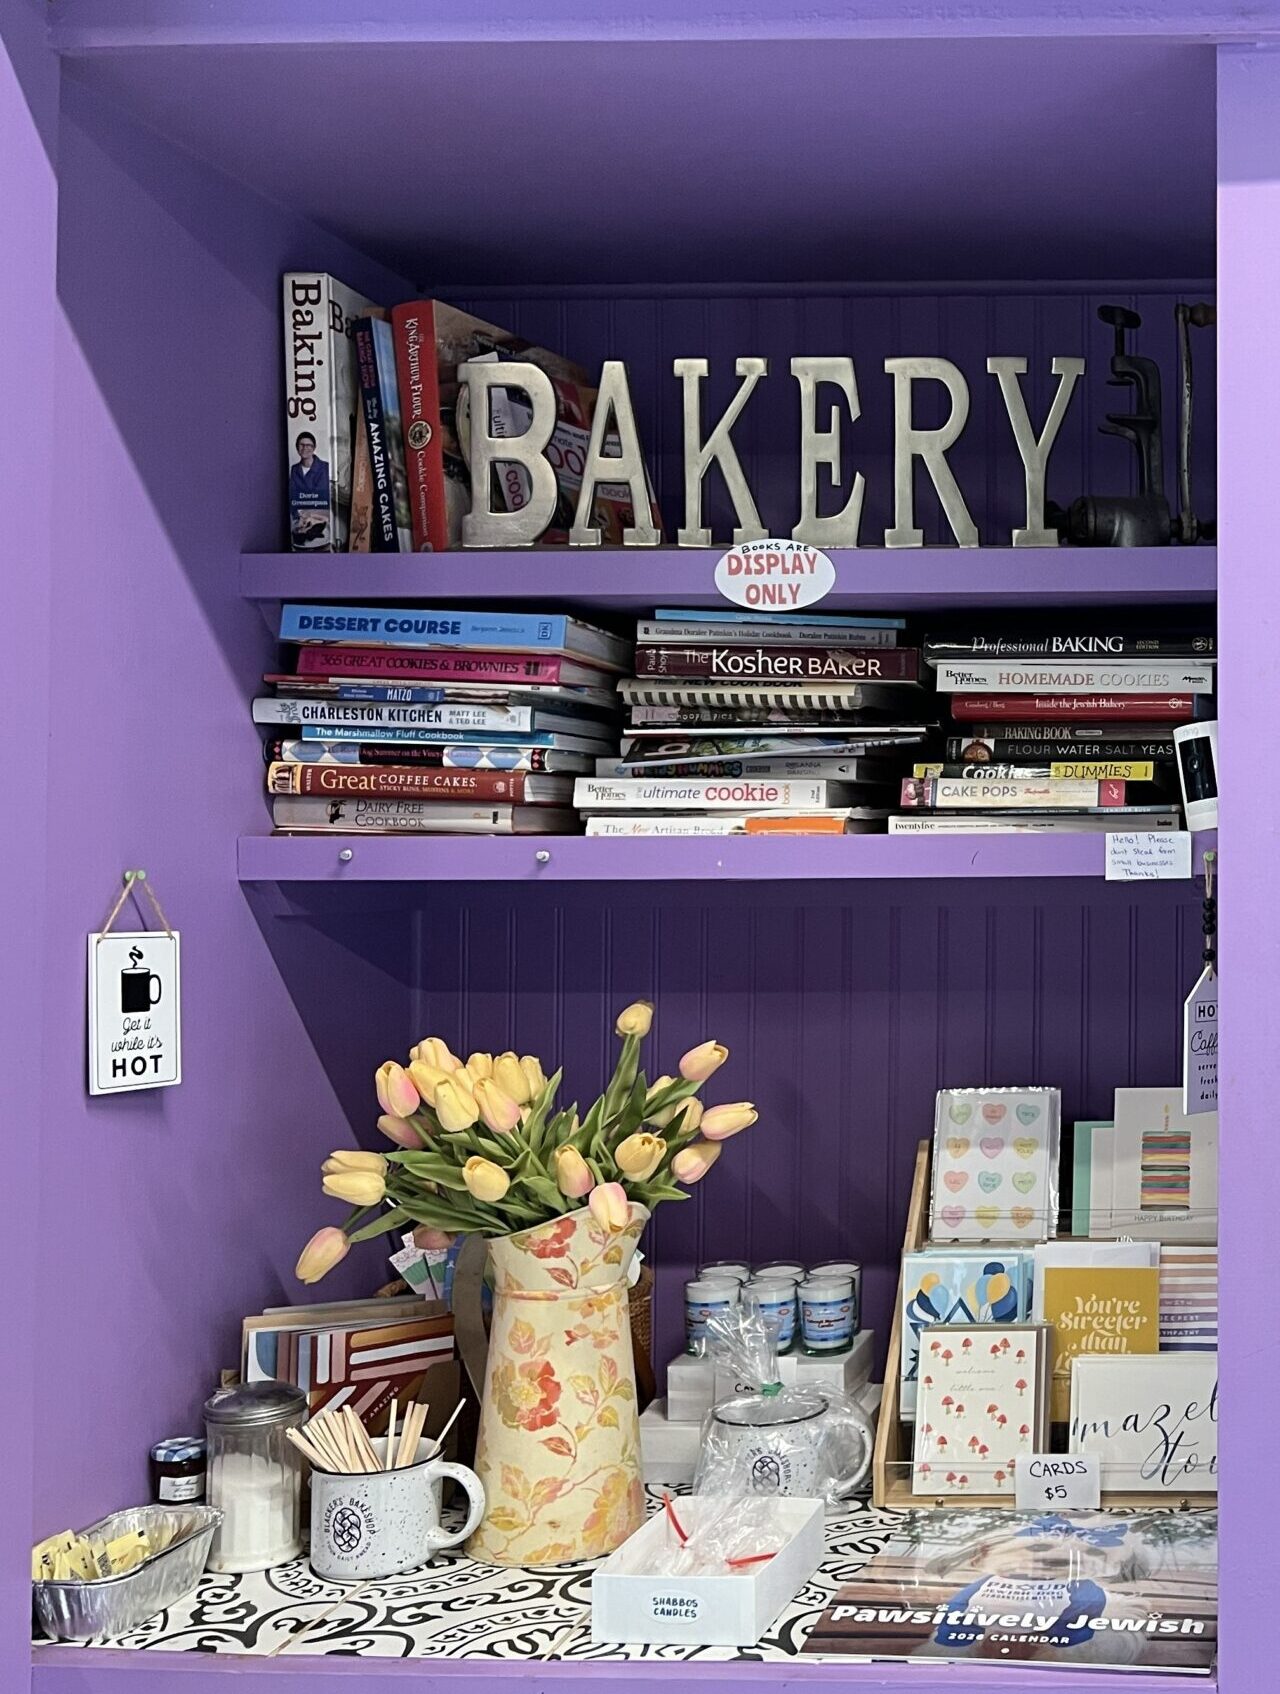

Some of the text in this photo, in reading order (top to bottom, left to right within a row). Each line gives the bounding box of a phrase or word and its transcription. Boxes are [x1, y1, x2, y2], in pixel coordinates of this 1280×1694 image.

[287, 279, 324, 422] Baking
[411, 385, 424, 420] FLOUR
[457, 357, 1085, 548] BAKERY
[369, 422, 394, 542] AMAZING CAKES
[786, 543, 811, 552] ARE
[727, 553, 818, 575] DISPLAY
[745, 583, 801, 605] ONLY
[298, 615, 382, 632] DESSERT
[384, 618, 462, 635] COURSE
[971, 636, 1124, 655] Professional BAKING
[343, 654, 385, 668] GREAT
[386, 656, 438, 670] COOKIES
[440, 660, 449, 671] &
[453, 661, 519, 674] BROWNIES
[684, 649, 709, 664] The
[945, 669, 974, 678] Better
[954, 677, 988, 685] Homes
[998, 672, 1095, 686] HOMEMADE
[1099, 673, 1170, 687] COOKIES
[386, 688, 412, 701] MATZO
[1035, 698, 1126, 710] Inside the Jewish Bakery
[302, 706, 442, 723] CHARLESTON KITCHEN
[316, 727, 465, 741] The Marshmallow Fluff Cookbook
[1004, 727, 1072, 740] BAKING BOOK
[1007, 744, 1174, 755] FLOUR WATER SALT YEAS
[1063, 763, 1132, 779] DUMMIES
[320, 769, 429, 791] Great COFFEE
[587, 784, 614, 793] Better
[595, 791, 627, 800] Homes
[643, 786, 701, 799] ultimate
[705, 782, 779, 801] cookie
[941, 786, 978, 797] CAKE
[982, 786, 1018, 797] POPS
[356, 800, 425, 814] DAIRY FREE
[355, 814, 426, 827] COOKBOOK
[894, 820, 936, 832] twentyfive
[603, 824, 625, 834] The
[653, 825, 690, 835] Artisan
[1112, 834, 1174, 844] Hello! Please
[1122, 868, 1159, 878] Thanks!
[1198, 1004, 1218, 1018] HO
[122, 1016, 151, 1035] Get it
[111, 1035, 163, 1052] while it's
[112, 1054, 163, 1078] HOT
[1134, 1214, 1194, 1222] HAPPY BIRTHDAY
[1074, 1293, 1141, 1314] You're
[1057, 1311, 1148, 1335] Sweeter
[1080, 1330, 1128, 1353] than
[956, 1366, 996, 1374] welcome
[950, 1383, 974, 1392] little
[370, 1386, 399, 1418] AMAZING
[1072, 1379, 1218, 1480] mazel
[1029, 1461, 1088, 1478] CARDS
[1044, 1484, 1068, 1501] $5
[323, 1497, 376, 1535] BLACKER'S BAKESHOP
[983, 1588, 1032, 1596] JEWISH
[652, 1596, 698, 1608] SHABBOS
[653, 1607, 697, 1618] CANDLES
[830, 1603, 1206, 1635] Pawsitively Jewish
[948, 1631, 1070, 1645] 2026 CALENDAR
